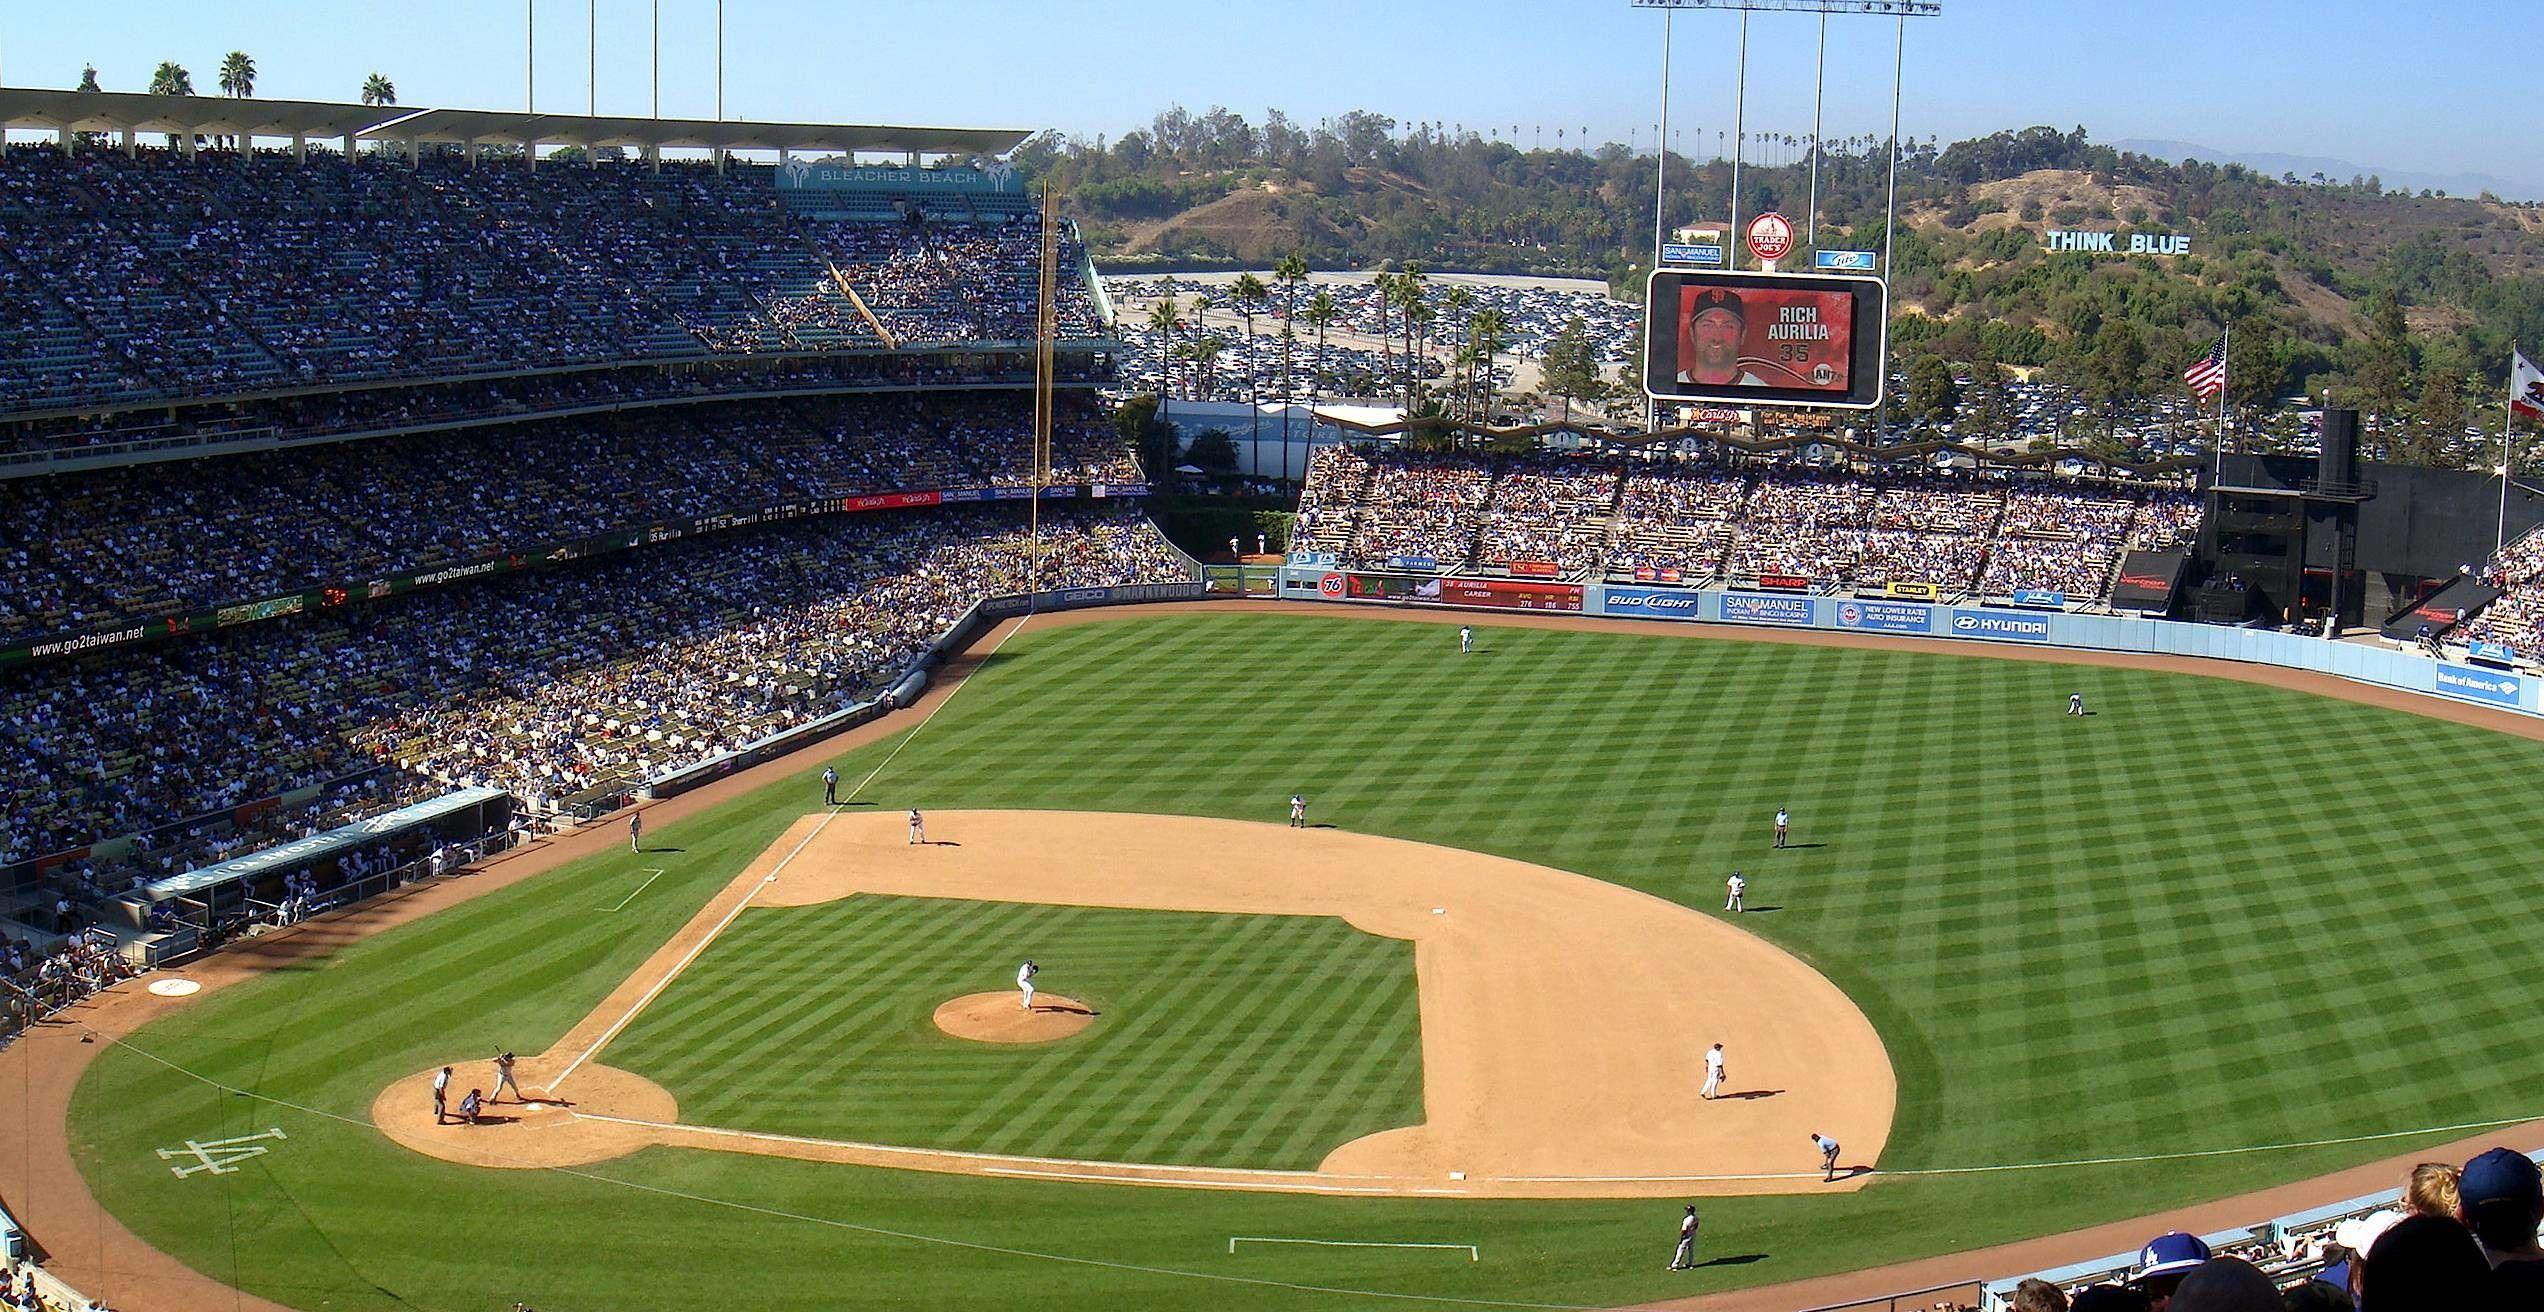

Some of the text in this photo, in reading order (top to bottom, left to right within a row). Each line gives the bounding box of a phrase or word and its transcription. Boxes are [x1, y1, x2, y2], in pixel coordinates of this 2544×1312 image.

[820, 171, 977, 183] BLEACHER BEACH
[1753, 236, 1786, 244] TRADER
[2047, 231, 2191, 255] THINK BLUE
[1665, 247, 1719, 257] SAN MANUEL
[1758, 243, 1781, 252] JOE'S
[1779, 307, 1817, 323] RICH
[1768, 324, 1829, 340] AURILIA
[1780, 344, 1809, 362] 35
[414, 559, 495, 586] www.go2taiwan.net
[1324, 577, 1343, 593] 76
[1760, 576, 1807, 586] SHARP
[1064, 589, 1105, 602] GEICO
[1464, 590, 1492, 598] CAREER
[1896, 585, 1928, 594] STANLEY
[1607, 595, 1694, 608] BUD LIGHT
[1727, 597, 1809, 611] SAN MANUEL
[1885, 615, 1926, 624] INSURANCE
[1981, 621, 2046, 634] HYUNDAI
[31, 625, 145, 657] www.go2taiwan.net
[2437, 671, 2458, 685] Bank
[2466, 678, 2498, 693] America
